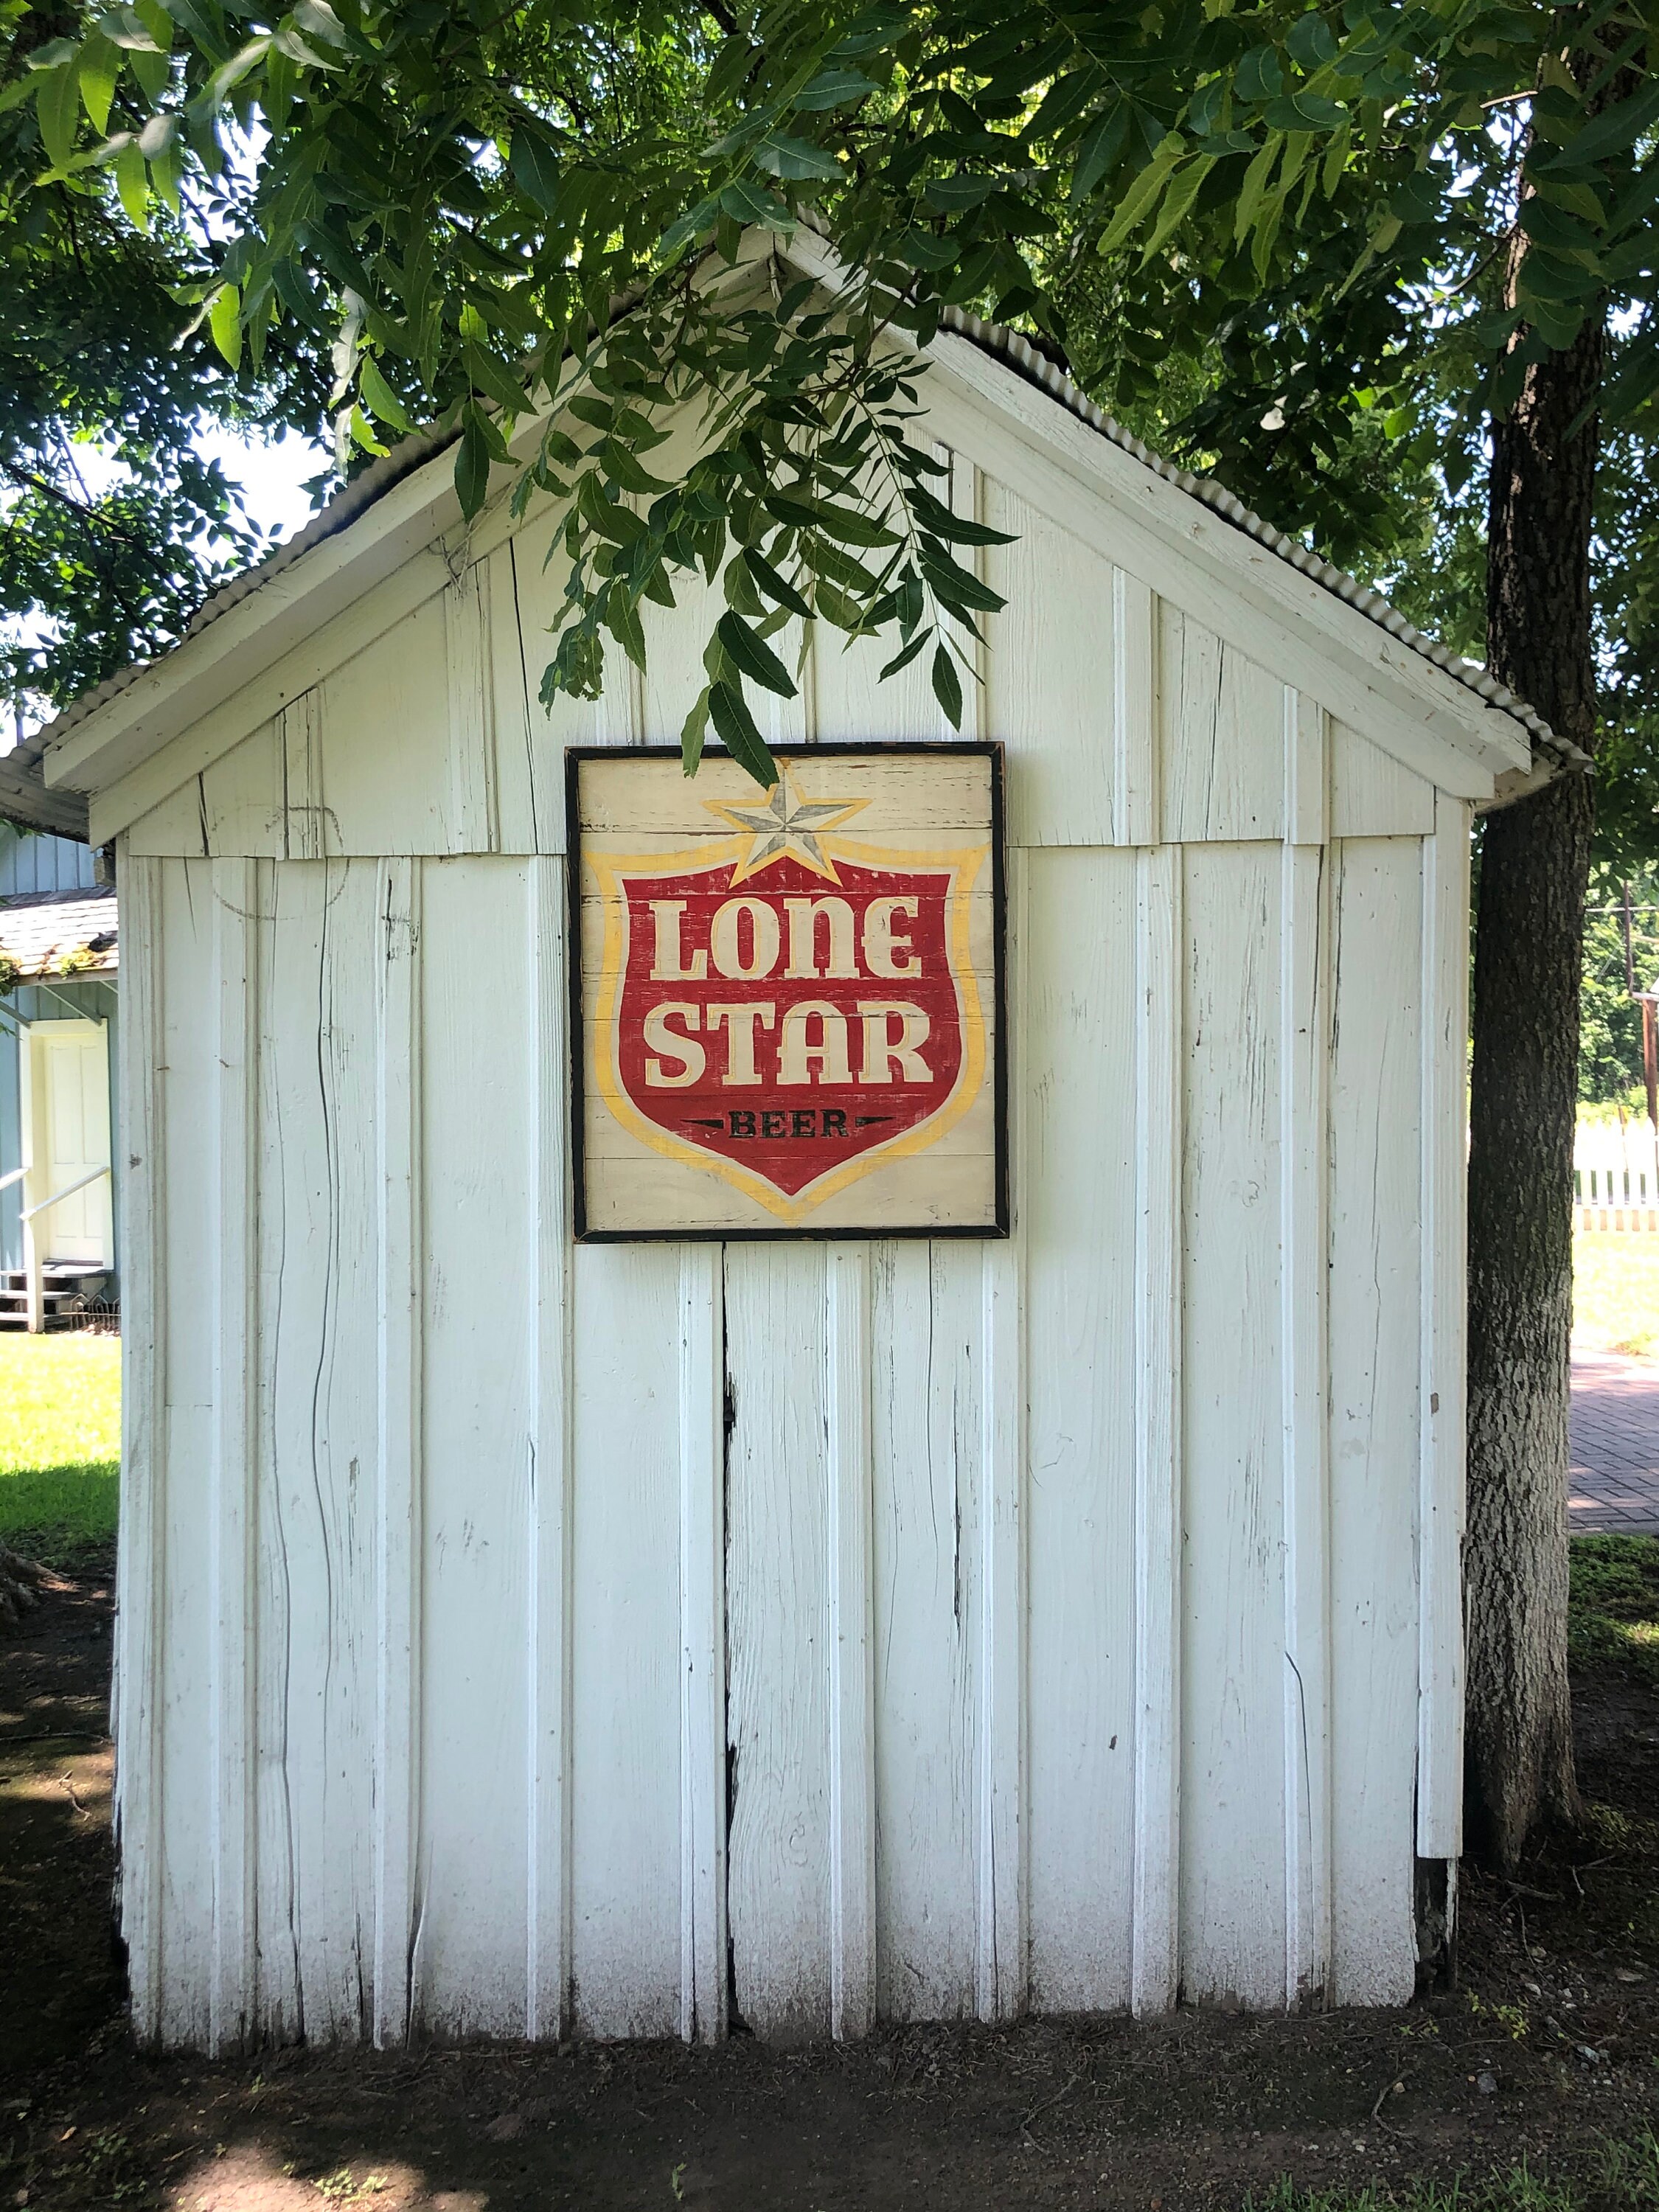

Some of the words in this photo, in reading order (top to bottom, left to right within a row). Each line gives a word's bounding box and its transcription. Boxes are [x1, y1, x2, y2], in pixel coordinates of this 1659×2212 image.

[649, 896, 922, 981] LONE
[643, 1000, 934, 1088] STAR
[728, 1109, 849, 1138] BEER
